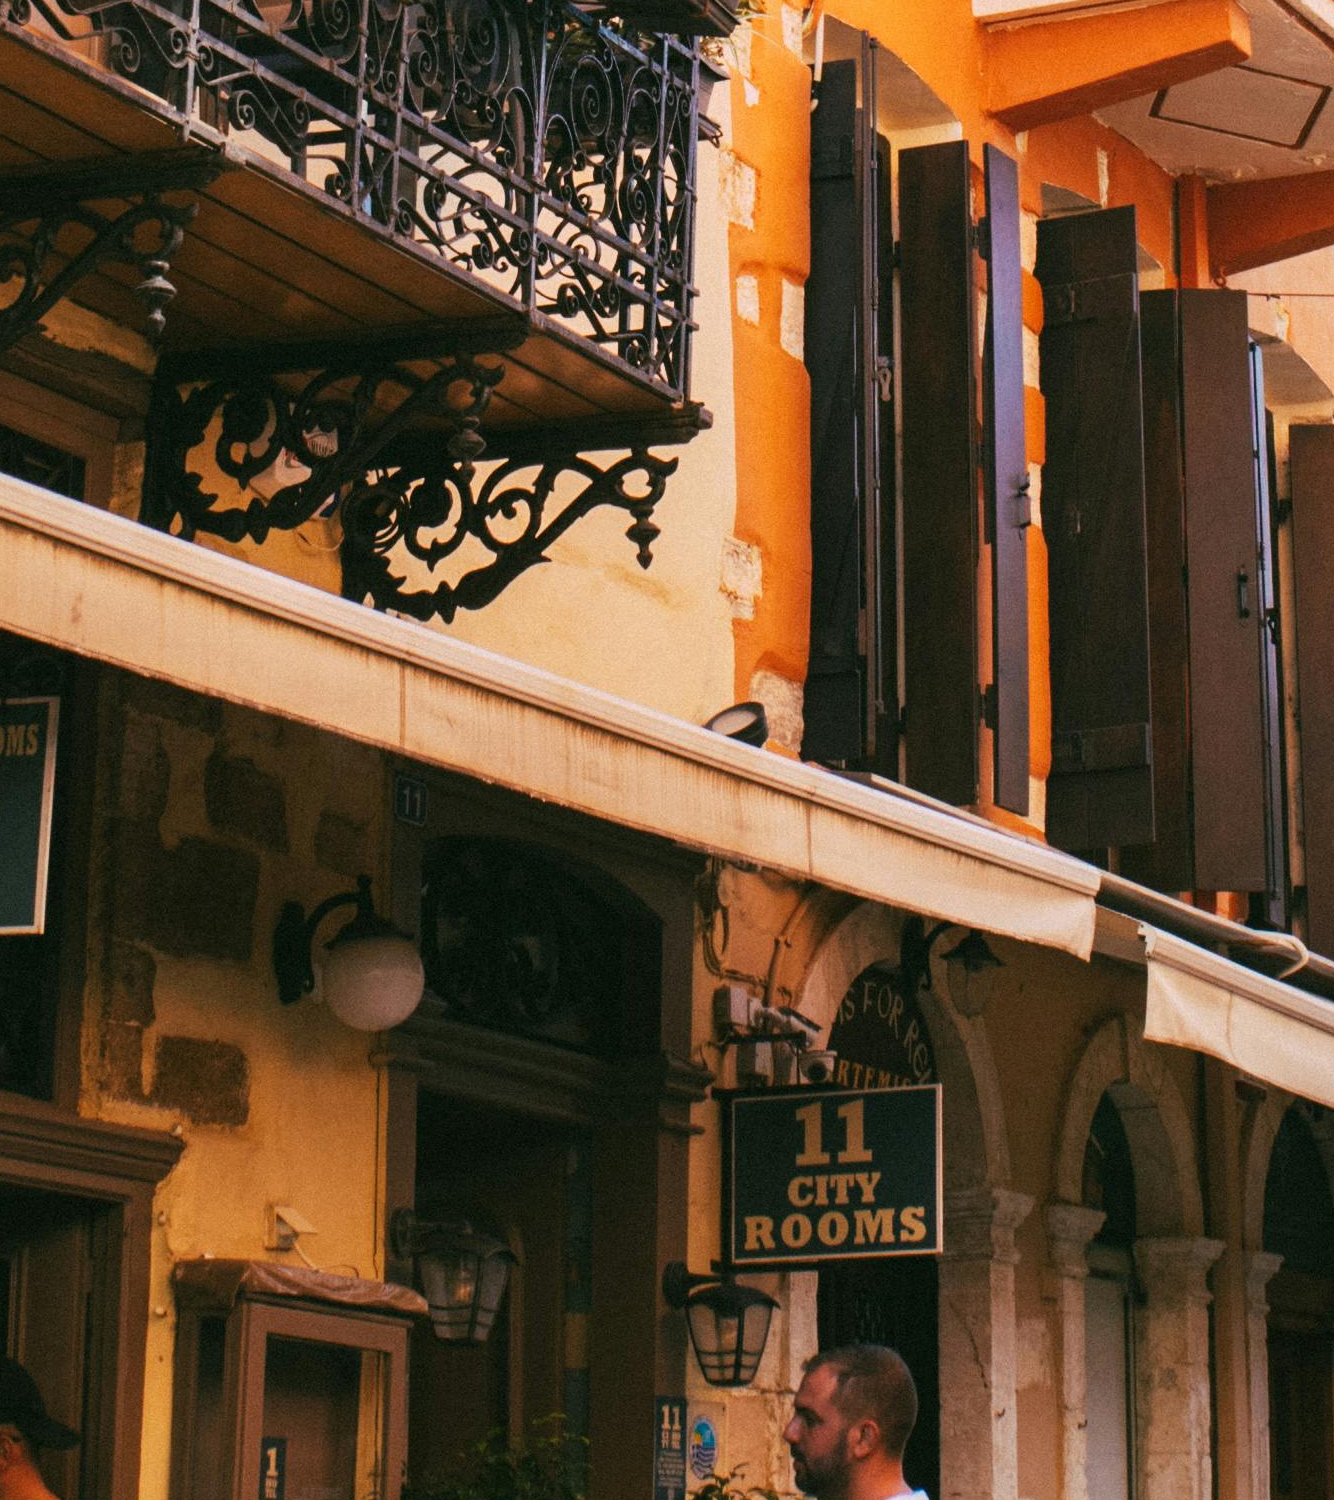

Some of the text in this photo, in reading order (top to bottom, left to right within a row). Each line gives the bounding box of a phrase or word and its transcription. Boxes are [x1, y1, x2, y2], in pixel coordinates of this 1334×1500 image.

[403, 787, 421, 817] 11
[795, 1099, 873, 1166] 11
[787, 1172, 881, 1207] CITY
[744, 1206, 927, 1250] ROOMS
